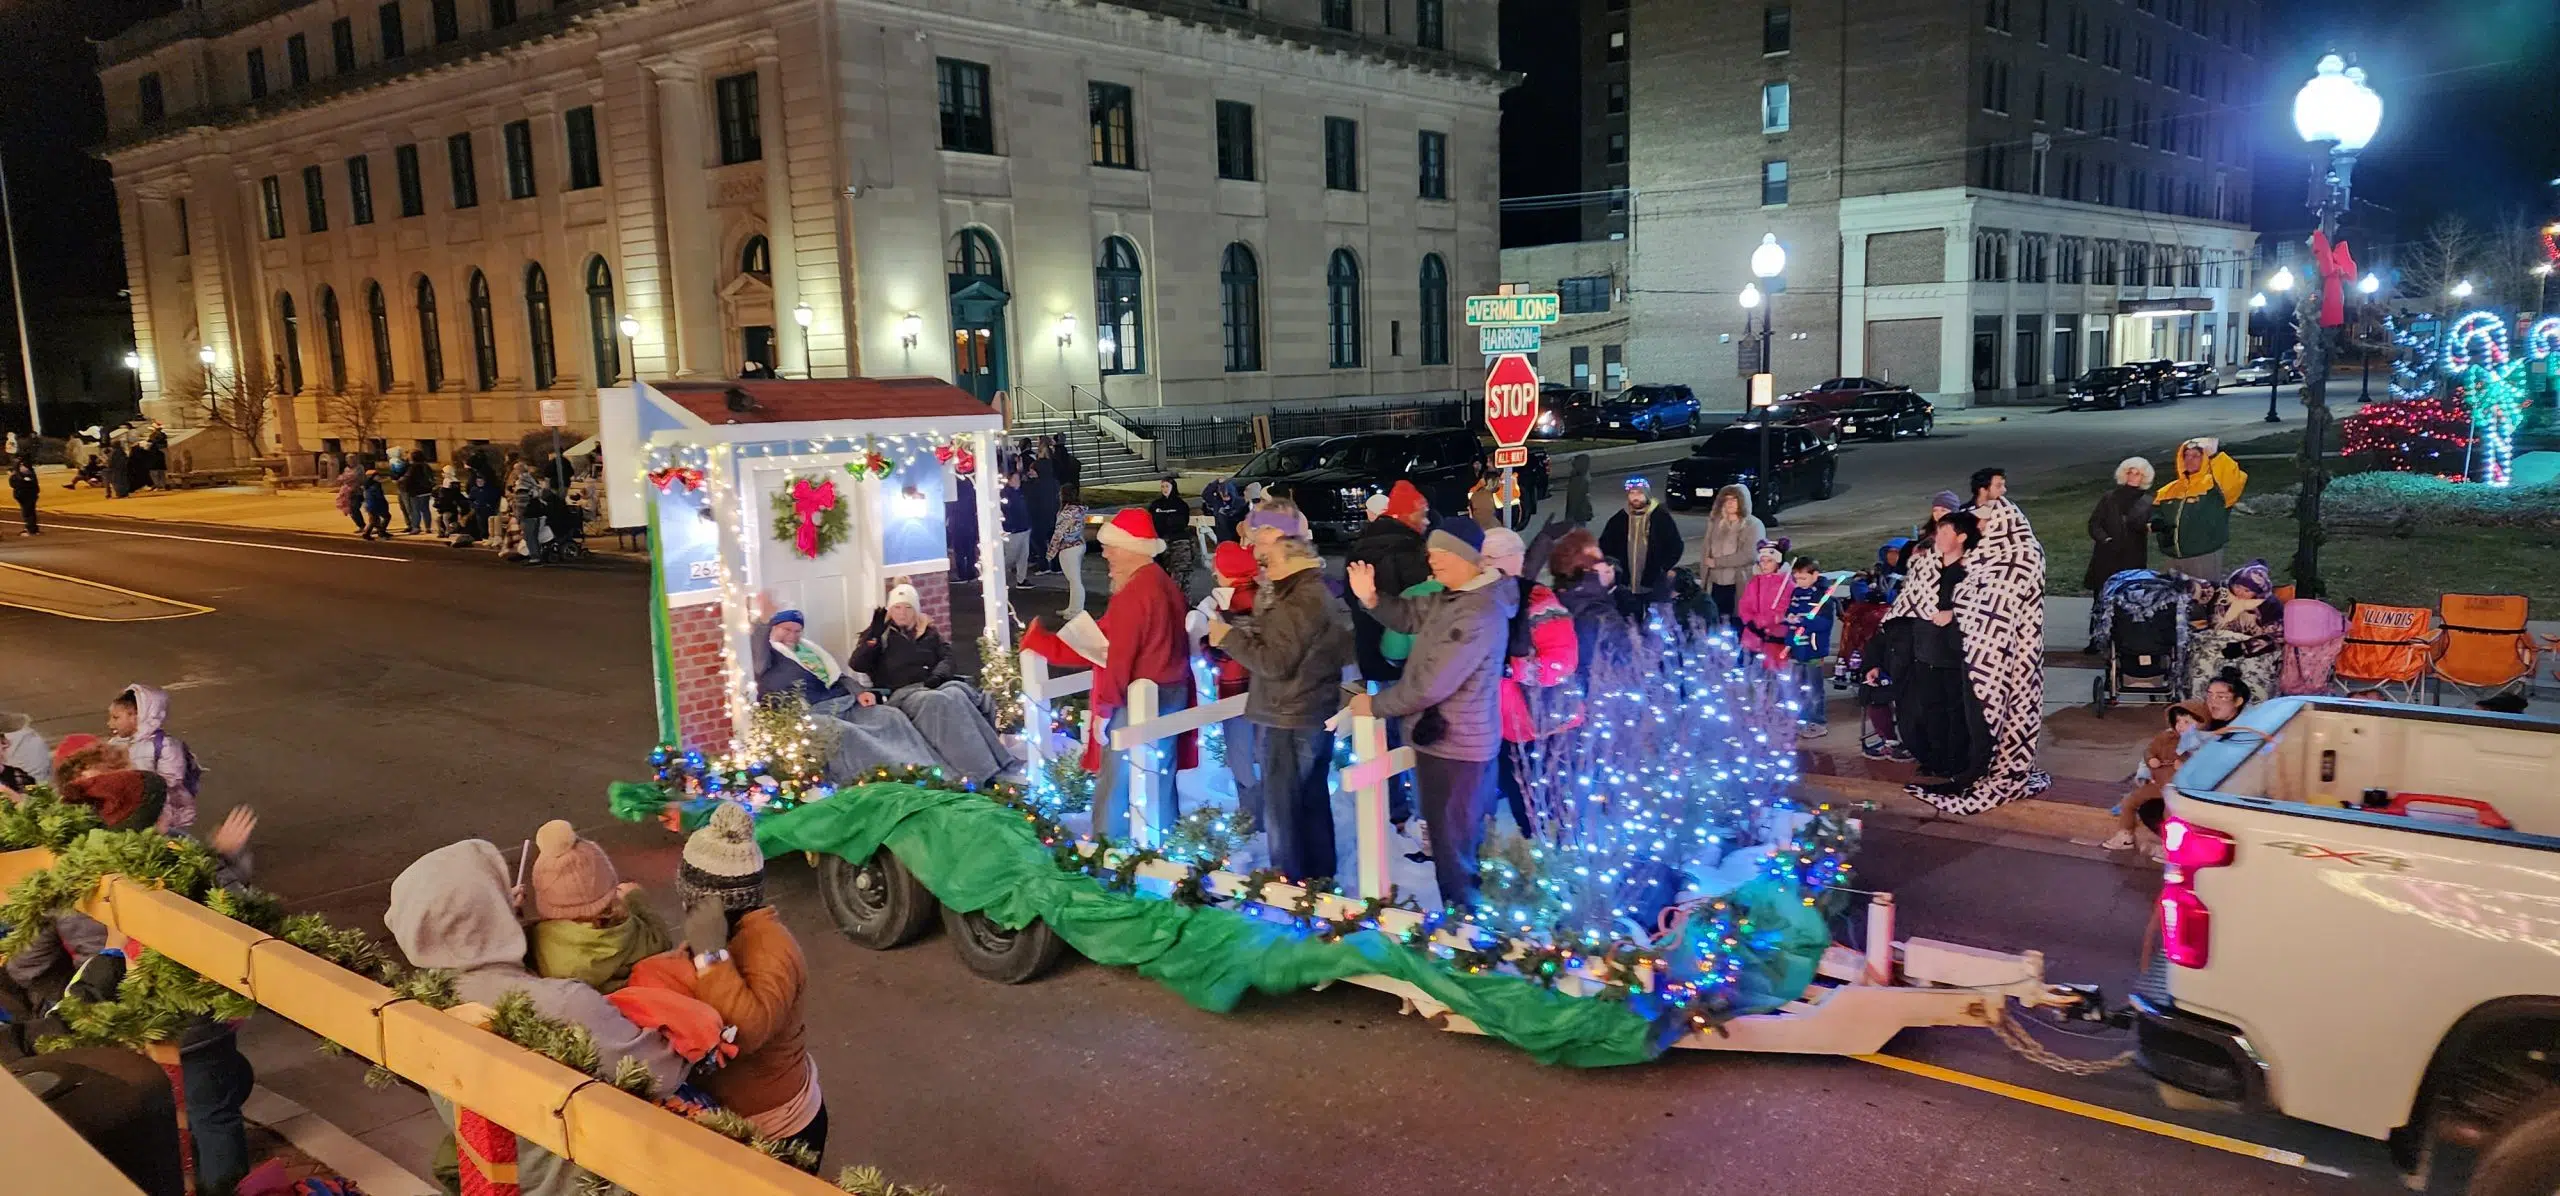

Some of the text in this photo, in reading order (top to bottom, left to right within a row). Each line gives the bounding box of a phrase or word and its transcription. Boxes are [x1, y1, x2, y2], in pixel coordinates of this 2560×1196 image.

[1474, 298, 1547, 321] VERMILION
[1547, 303, 1555, 316] ST
[1482, 328, 1533, 350] HARRISON
[1490, 382, 1535, 419] STOP
[1498, 450, 1525, 463] ALL WAY
[2364, 609, 2415, 626] ILLINOIS
